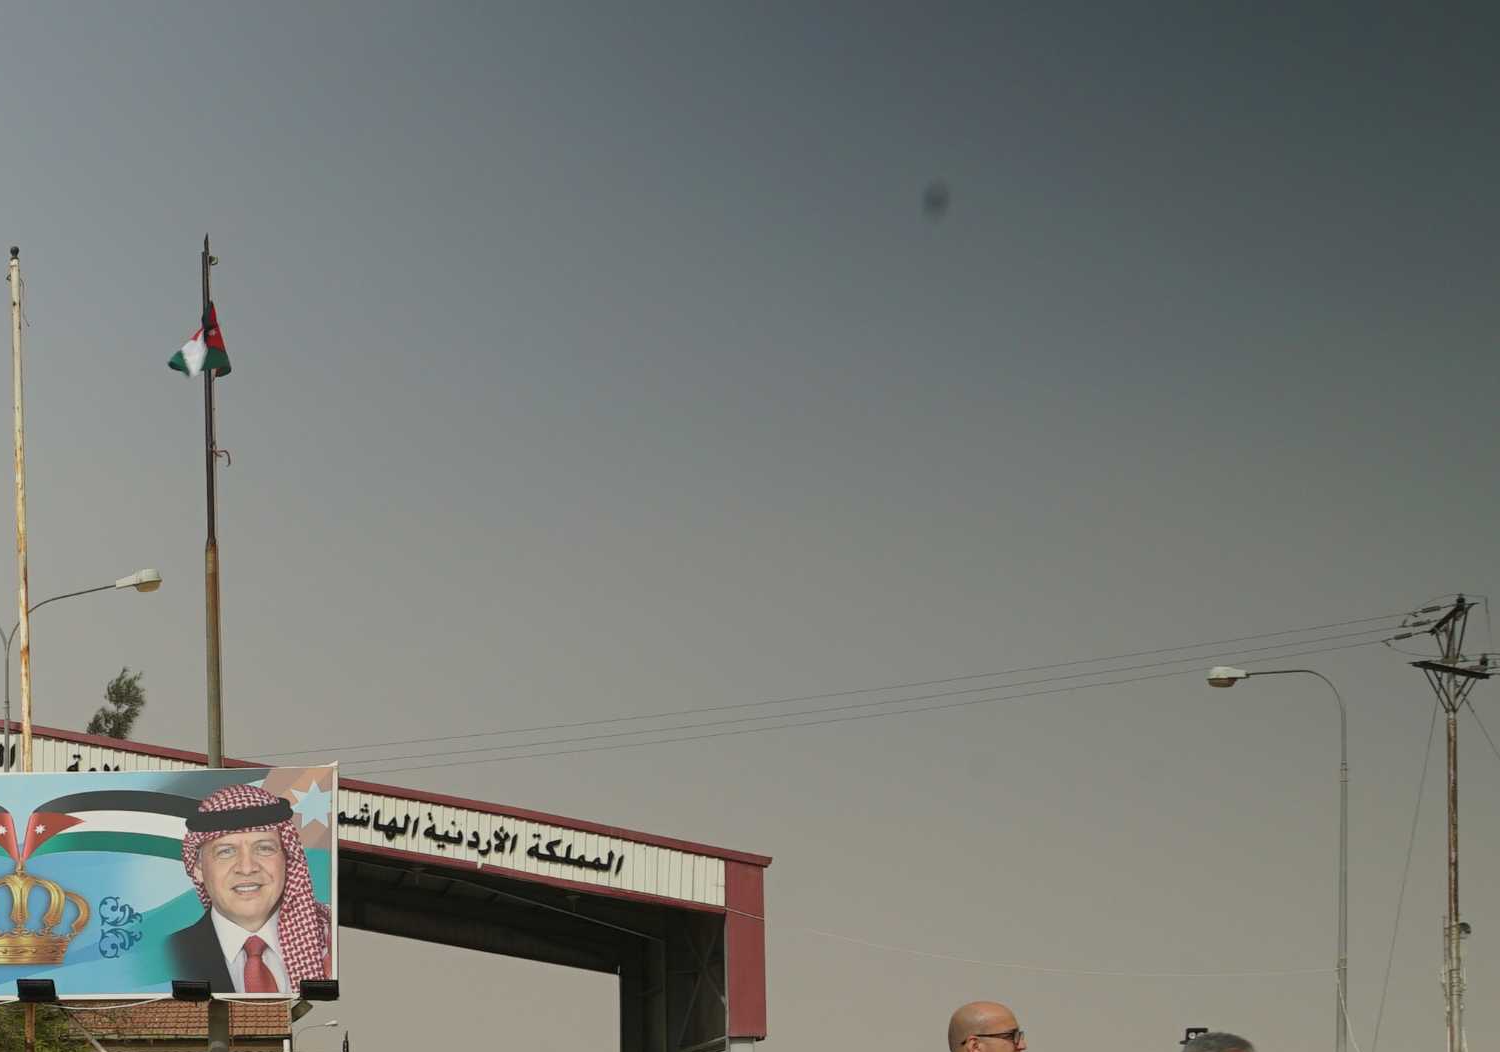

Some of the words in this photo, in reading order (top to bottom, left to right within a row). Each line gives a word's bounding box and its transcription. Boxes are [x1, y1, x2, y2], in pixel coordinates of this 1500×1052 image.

[338, 803, 420, 842] الهاشم
[423, 811, 519, 856] الأردنية
[526, 835, 624, 876] المملكة
